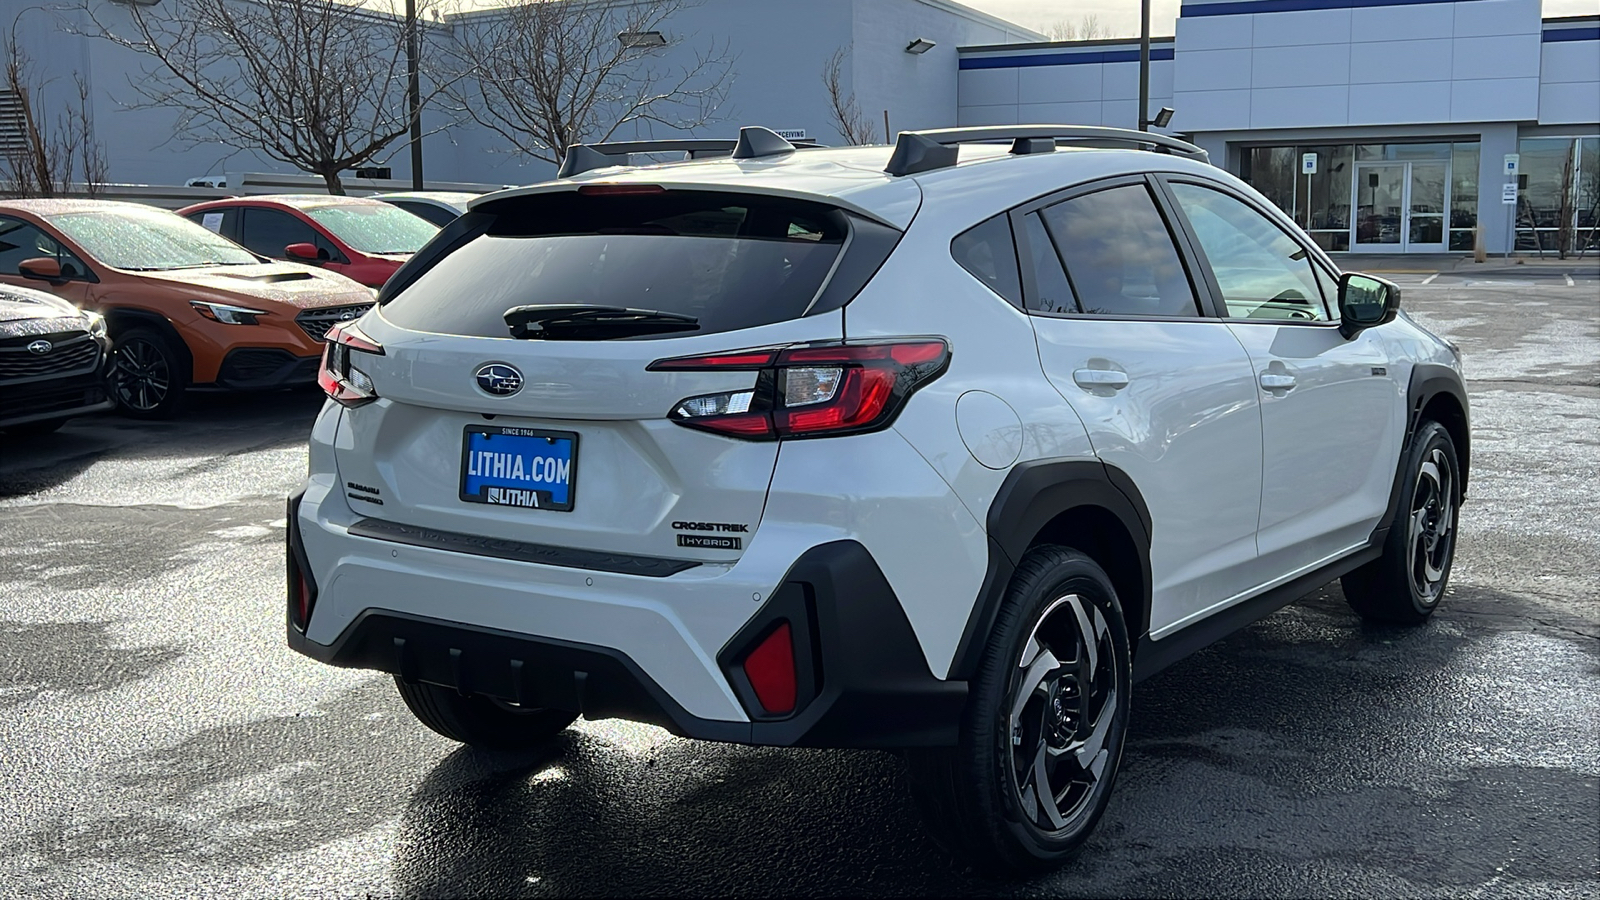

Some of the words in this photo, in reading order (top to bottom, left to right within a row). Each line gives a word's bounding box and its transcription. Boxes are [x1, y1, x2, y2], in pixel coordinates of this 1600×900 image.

[502, 427, 519, 435] SINCE
[520, 429, 534, 437] 1946
[468, 450, 570, 485] LITHIA.COM
[499, 488, 539, 507] LITHIA
[671, 521, 749, 533] CROSSTREK
[686, 538, 730, 547] HYBRID
